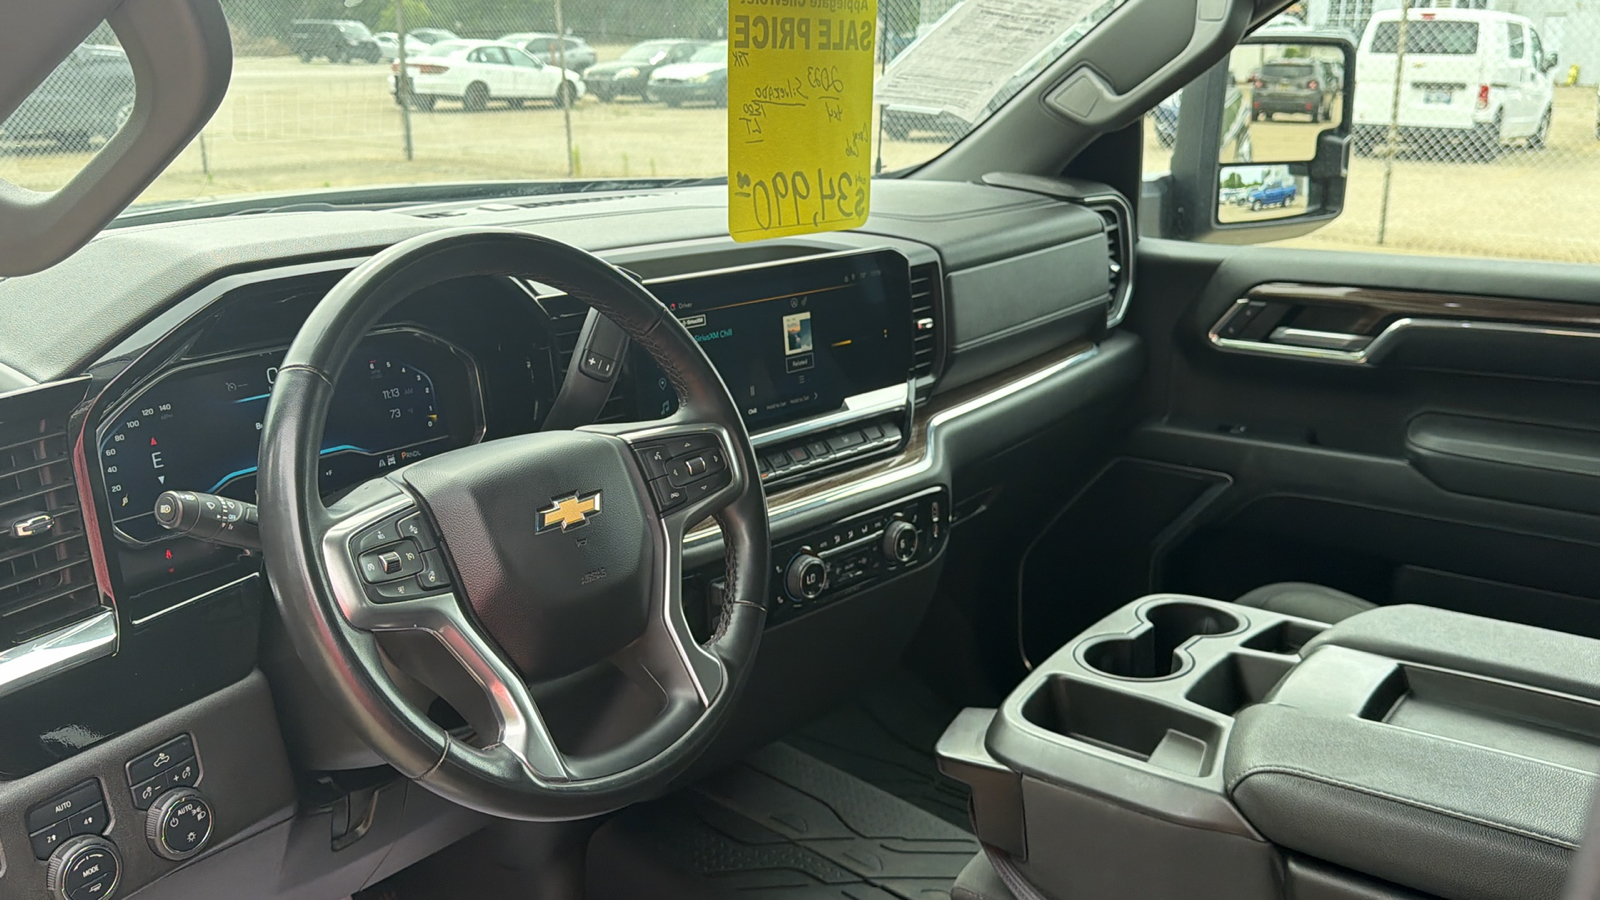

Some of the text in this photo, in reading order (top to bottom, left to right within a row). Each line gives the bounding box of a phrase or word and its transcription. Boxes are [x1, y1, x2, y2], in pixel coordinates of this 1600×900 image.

[678, 302, 693, 310] Driver
[720, 328, 733, 338] Chill
[382, 387, 400, 400] 11:13
[141, 407, 155, 417] 120
[158, 403, 172, 412] 140
[389, 408, 402, 419] 73
[126, 420, 140, 429] 100
[114, 433, 125, 442] 80
[105, 448, 116, 457] 60
[151, 451, 165, 469] E
[111, 484, 122, 493] 20
[806, 572, 816, 585] LO
[54, 800, 72, 813] AUTO
[177, 803, 193, 816] AUTO
[82, 864, 100, 878] MODE
